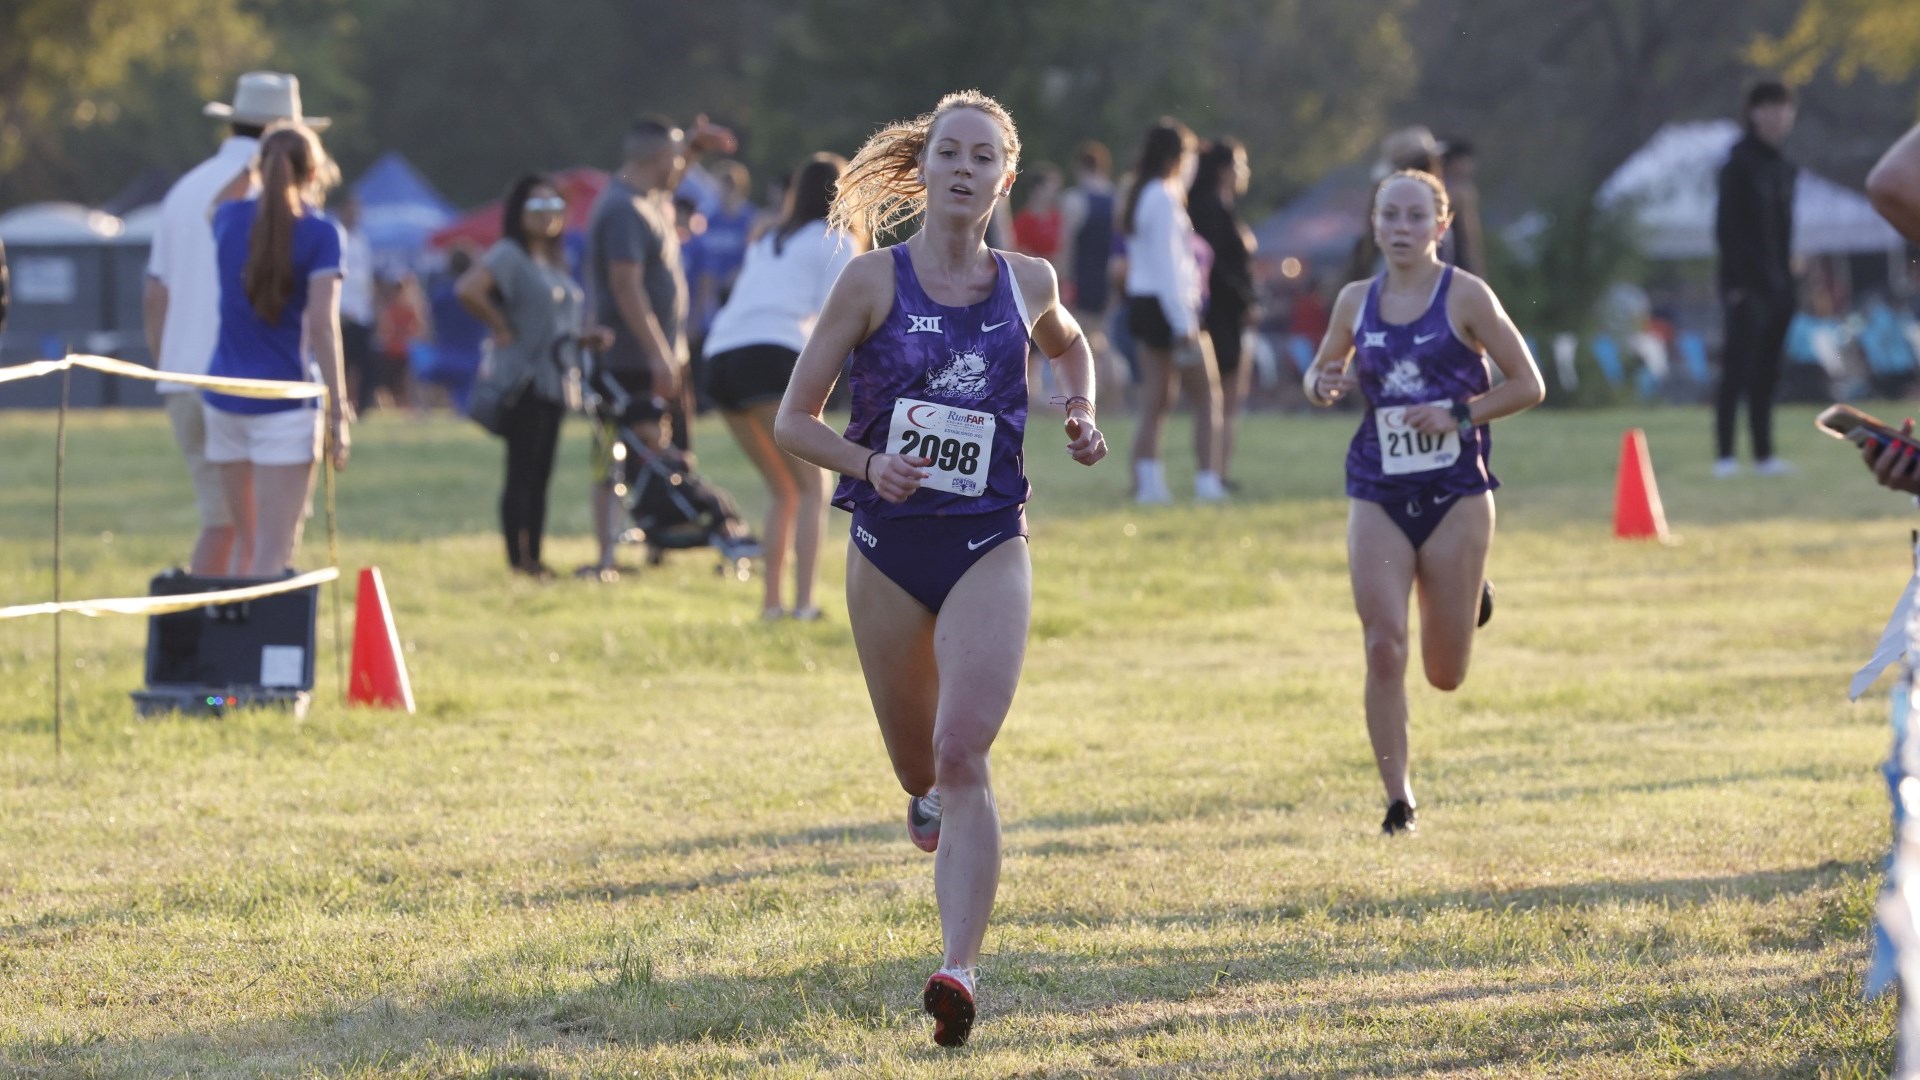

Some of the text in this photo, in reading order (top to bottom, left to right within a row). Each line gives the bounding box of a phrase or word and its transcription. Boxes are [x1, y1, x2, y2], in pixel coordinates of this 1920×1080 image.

[907, 314, 943, 334] XII
[899, 430, 980, 475] 2098
[856, 525, 877, 548] TCU
